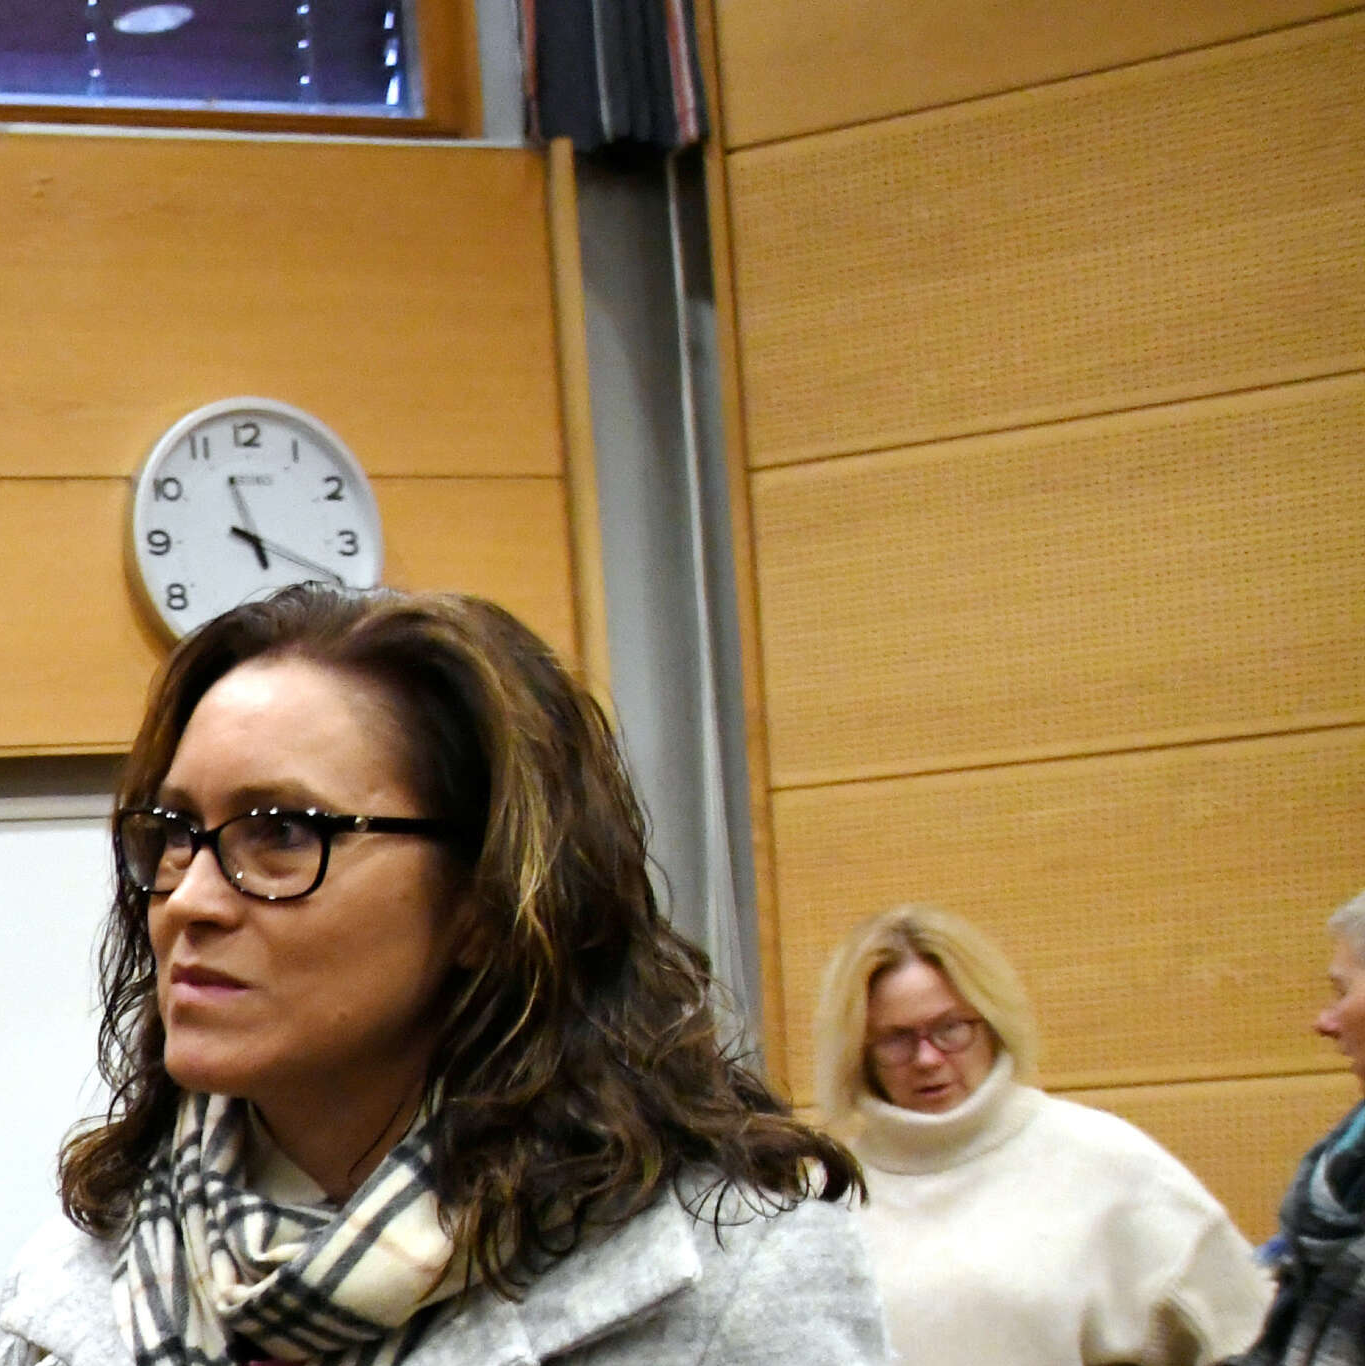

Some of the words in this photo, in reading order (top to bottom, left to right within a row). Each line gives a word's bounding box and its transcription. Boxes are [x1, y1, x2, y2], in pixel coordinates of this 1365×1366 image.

[190, 436, 211, 460] 11
[233, 423, 261, 448] 12
[292, 439, 300, 463] 1
[153, 477, 183, 501] 10
[324, 476, 344, 501] 2
[147, 530, 171, 556] 9
[337, 530, 360, 556] 3
[166, 583, 190, 611] 8
